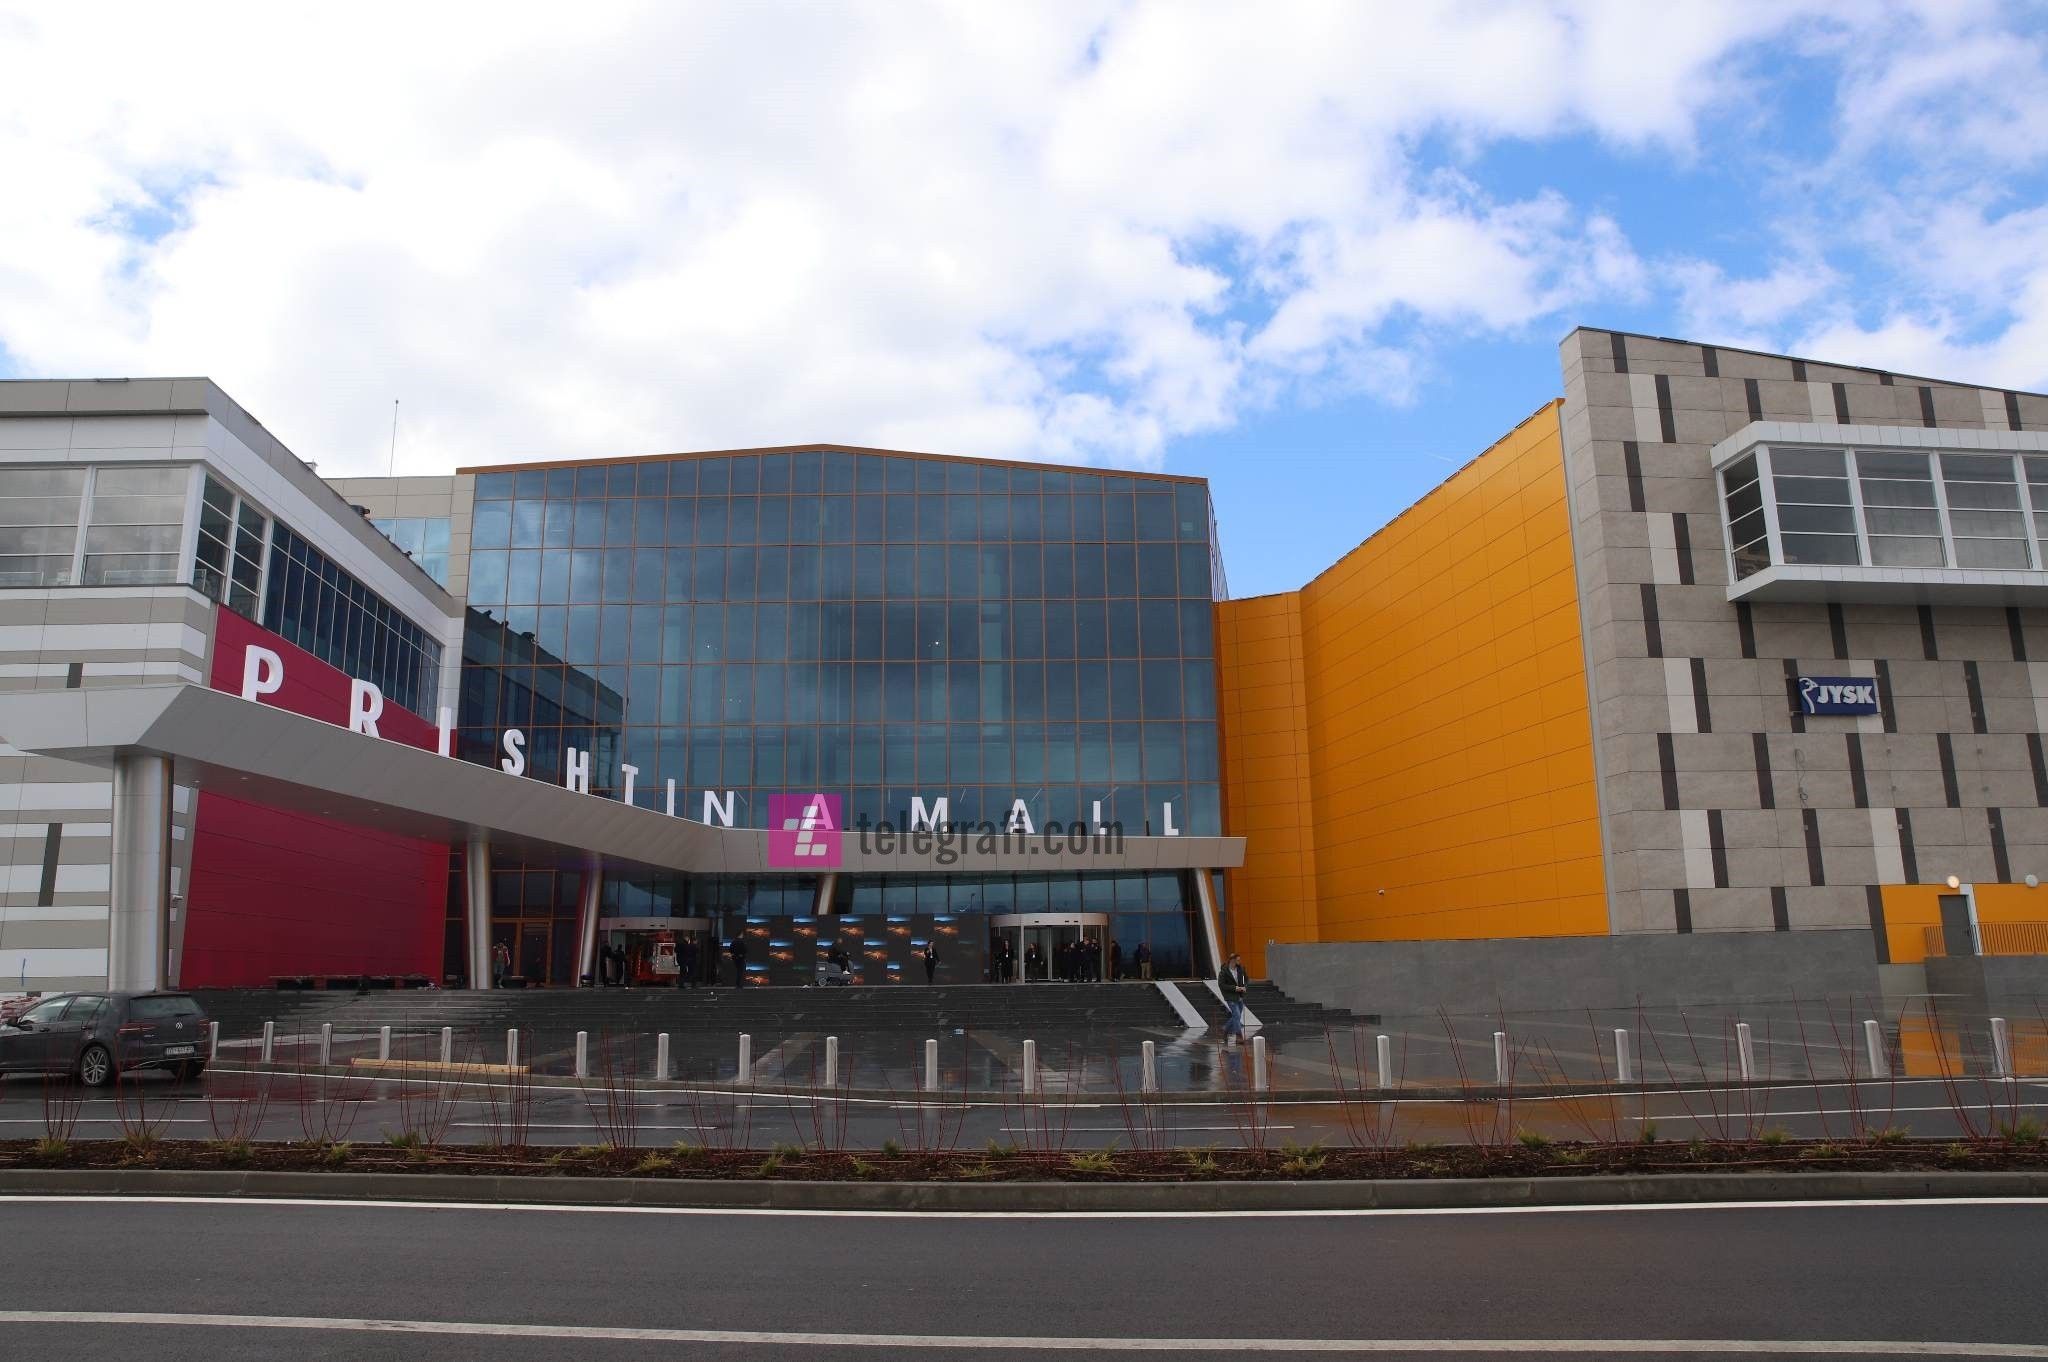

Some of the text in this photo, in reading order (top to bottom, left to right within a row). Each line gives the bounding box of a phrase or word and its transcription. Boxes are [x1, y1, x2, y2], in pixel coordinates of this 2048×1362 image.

[241, 644, 1180, 837] PRISHTINA MALL
[1817, 685, 1875, 704] JYSK
